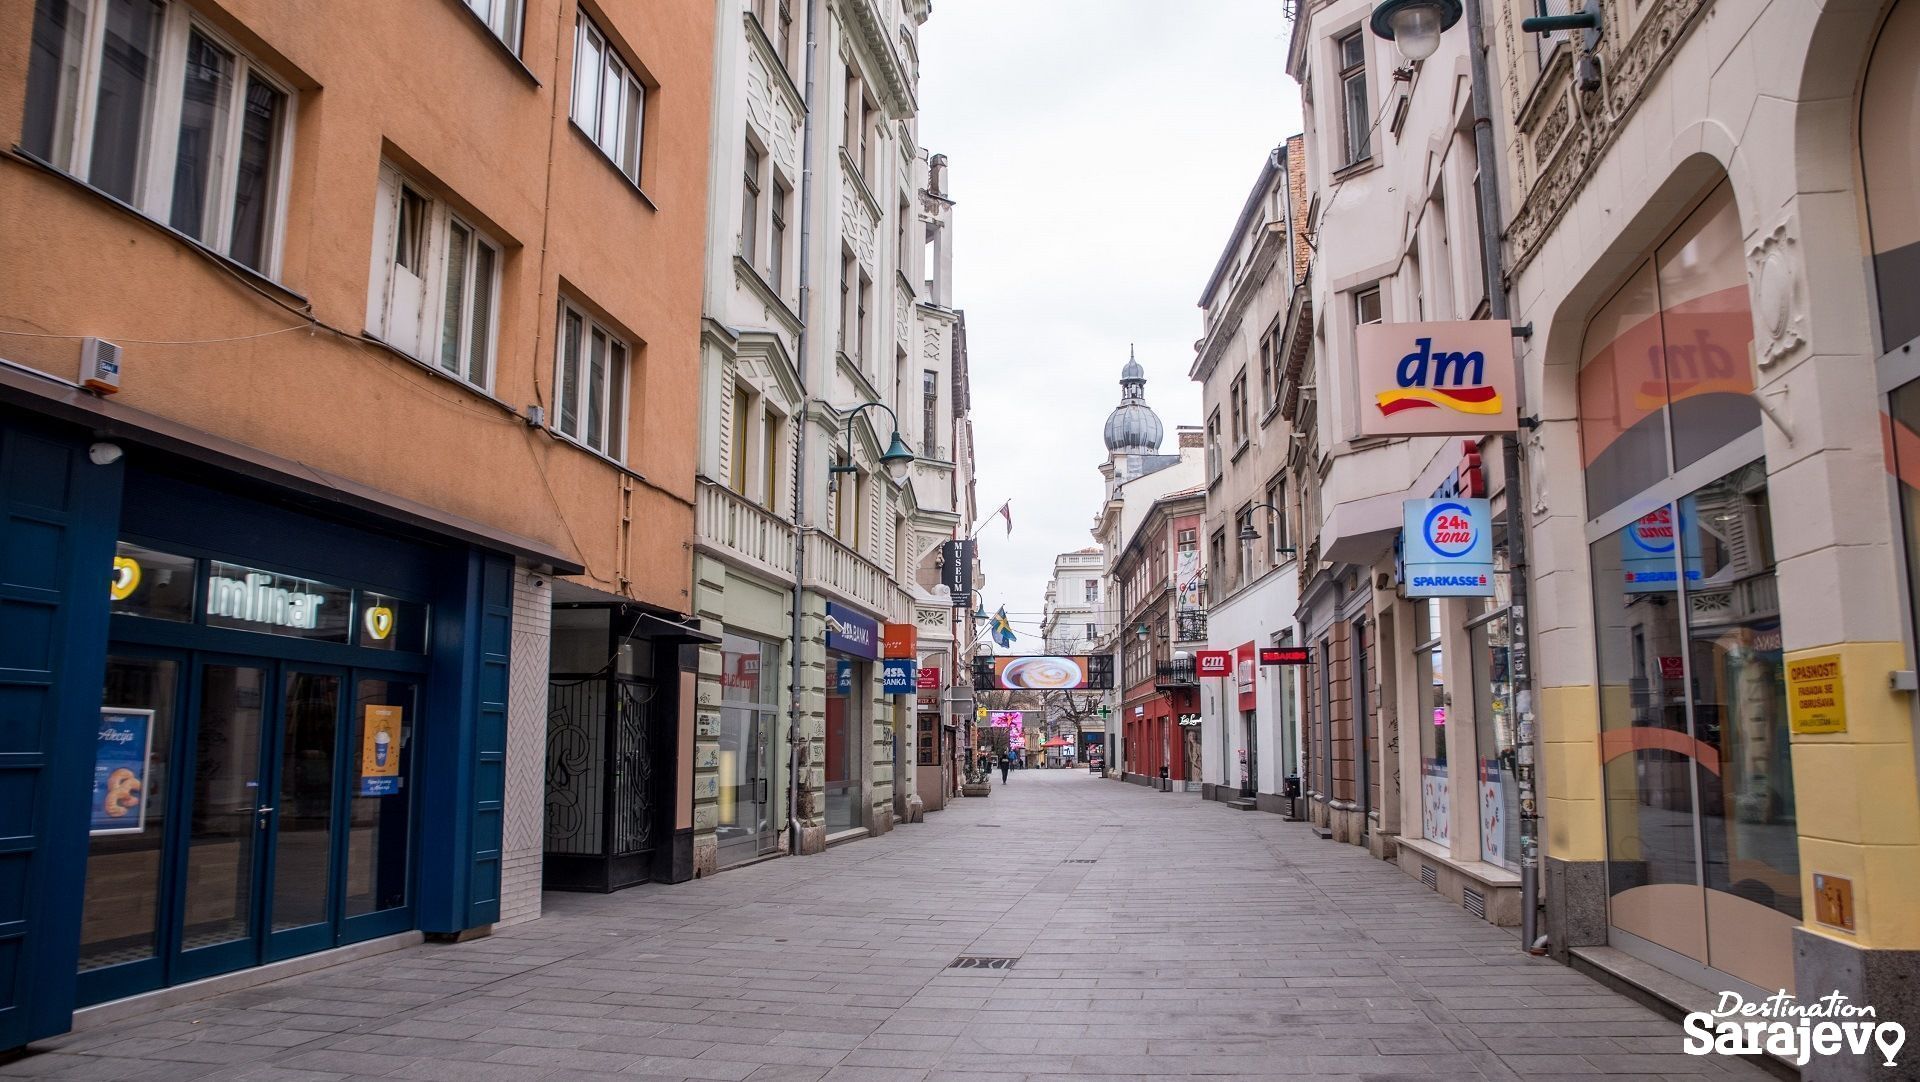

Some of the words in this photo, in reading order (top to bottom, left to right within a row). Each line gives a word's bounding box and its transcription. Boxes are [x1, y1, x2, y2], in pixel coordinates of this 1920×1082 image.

[1397, 338, 1484, 388] dm
[1437, 515, 1468, 530] 24h
[1434, 531, 1470, 544] zona
[954, 542, 963, 592] MUSEUM
[1413, 576, 1478, 587] SPARKASSE
[206, 573, 325, 630] mlinar
[1202, 656, 1224, 667] cm
[883, 667, 906, 678] ASA
